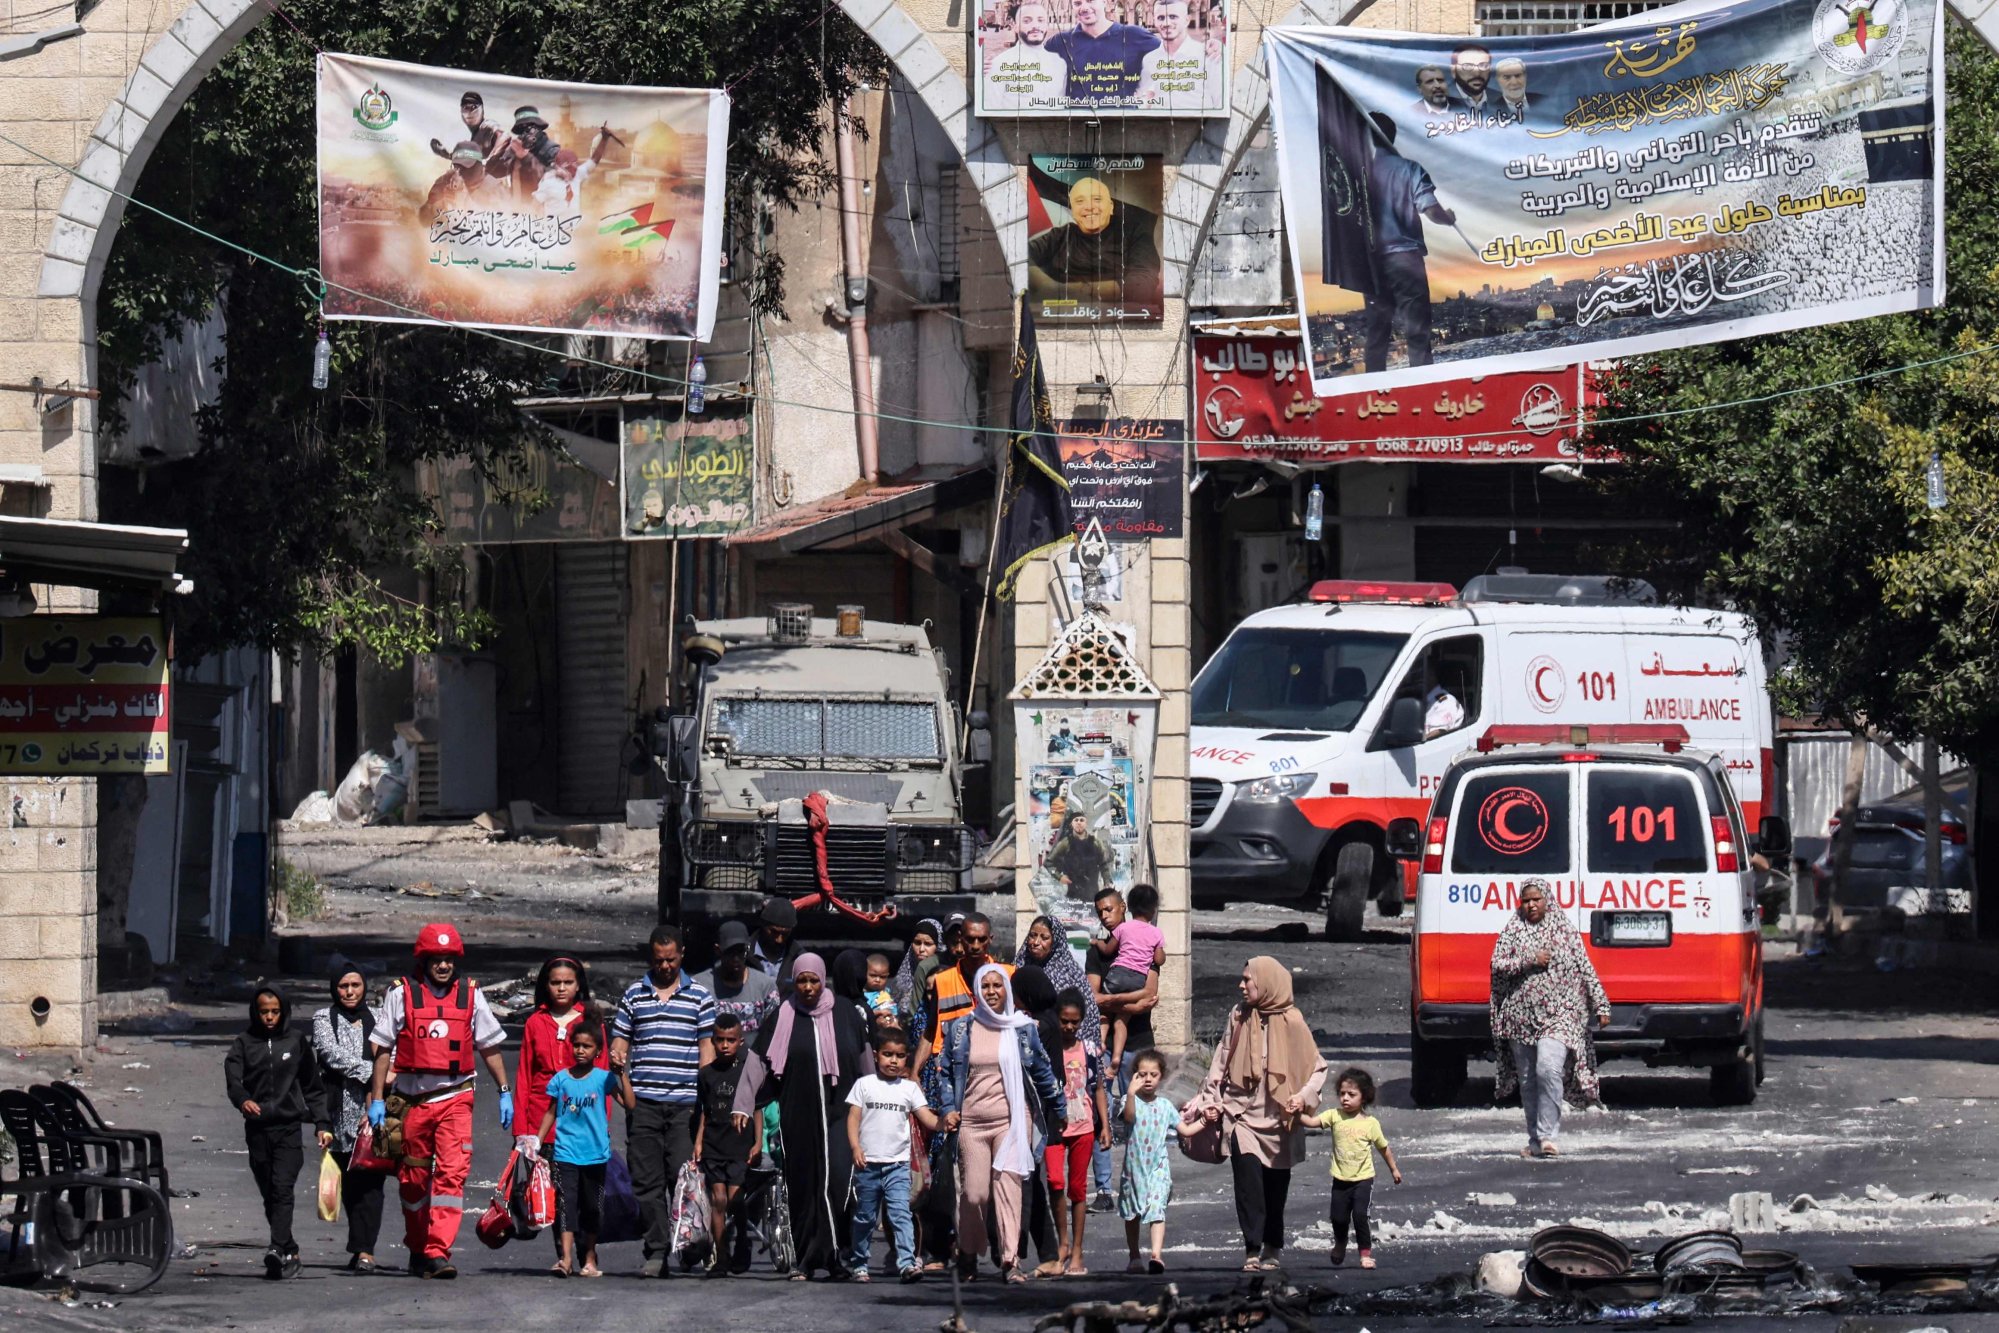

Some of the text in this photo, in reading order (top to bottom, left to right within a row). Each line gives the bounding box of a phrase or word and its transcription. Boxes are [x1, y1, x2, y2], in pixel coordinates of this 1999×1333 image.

[1603, 21, 1699, 79] تهنئة
[1425, 107, 1483, 138] المقاومة
[1504, 111, 1822, 181] تتقدم بأحر التهاني والتبريكات
[1521, 150, 1816, 218] من الأمة الإسلامية والعربية
[1480, 184, 1867, 267] بمناسبة حلول عيد الأضحى المبارك
[430, 250, 480, 269] مبارك
[541, 260, 577, 275] عيد
[1203, 342, 1268, 382] طالب
[1357, 394, 1399, 420] عجل
[1433, 390, 1485, 420] خاروف
[1056, 421, 1110, 438] المسا
[1070, 496, 1097, 508] السلا
[24, 623, 160, 675] معرض
[1577, 671, 1617, 701] 101
[55, 693, 118, 728] منزلي
[1644, 698, 1741, 721] AMBULANCE
[1269, 755, 1300, 774] 801
[1608, 805, 1676, 842] 101
[1448, 878, 1688, 911] 810 AMULANCE
[874, 1101, 899, 1112] SPORT
